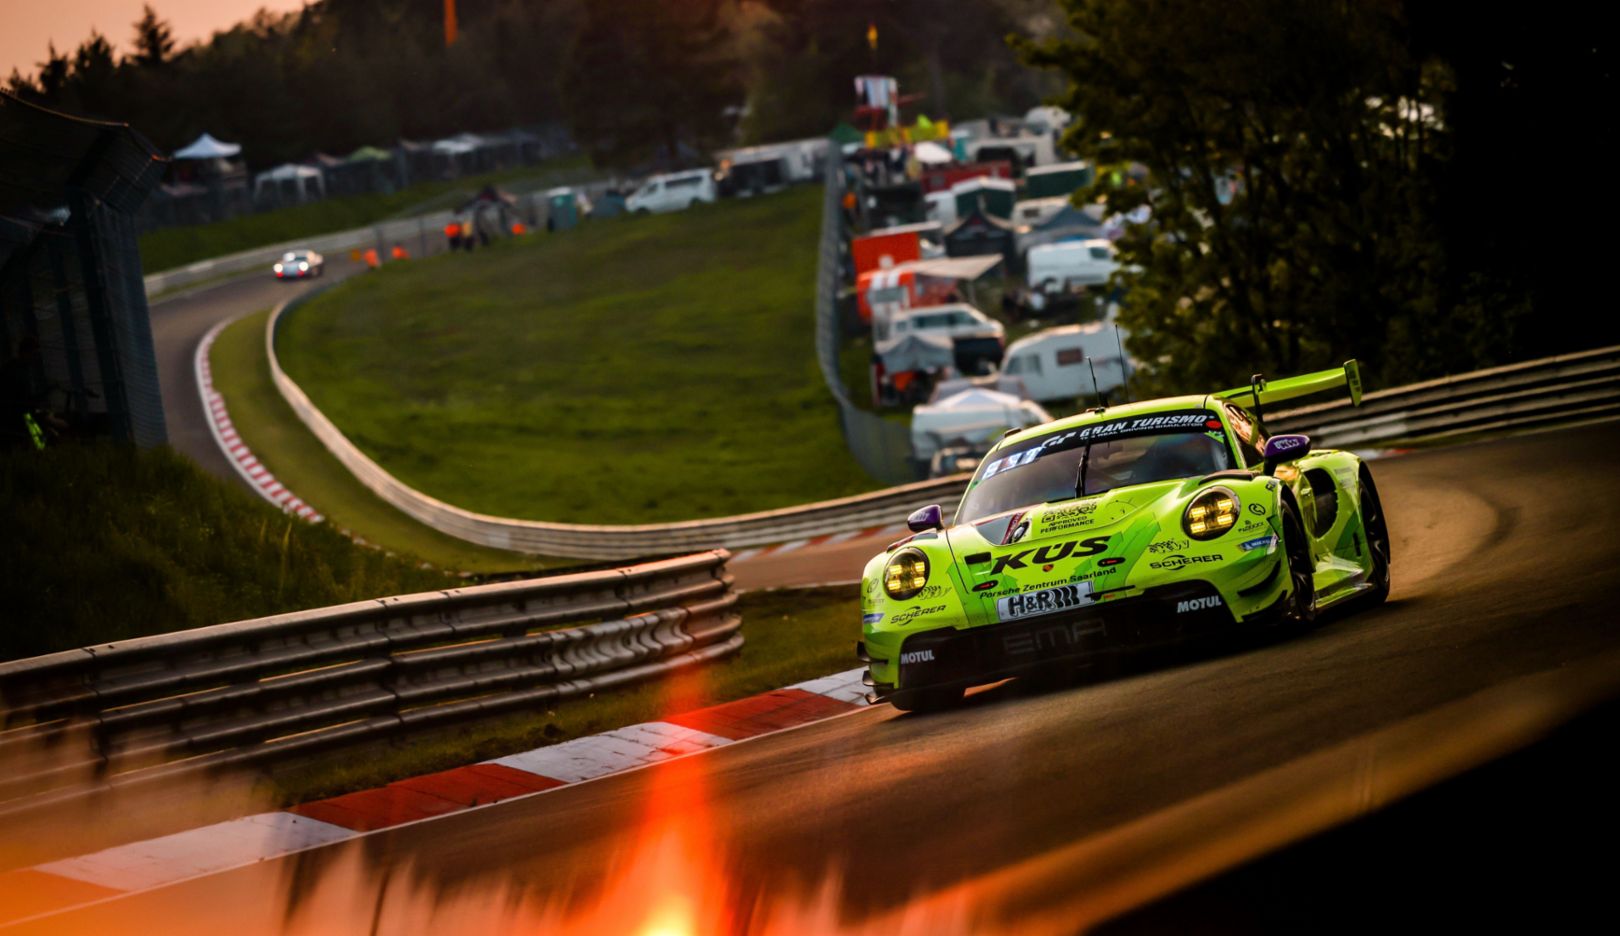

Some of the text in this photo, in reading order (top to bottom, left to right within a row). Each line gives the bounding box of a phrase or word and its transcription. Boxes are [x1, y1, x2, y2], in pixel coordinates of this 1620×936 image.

[1080, 415, 1207, 438] GRAN TURISMO
[1040, 519, 1095, 533] PERFORMANCE
[990, 535, 1112, 575] KÜS
[1149, 554, 1224, 570] SCHERER
[979, 567, 1117, 599] Porsche Zentrum Saarland
[1177, 595, 1222, 613] MOTUL
[890, 605, 947, 625] SCHERER
[901, 650, 935, 664] MOTUL
